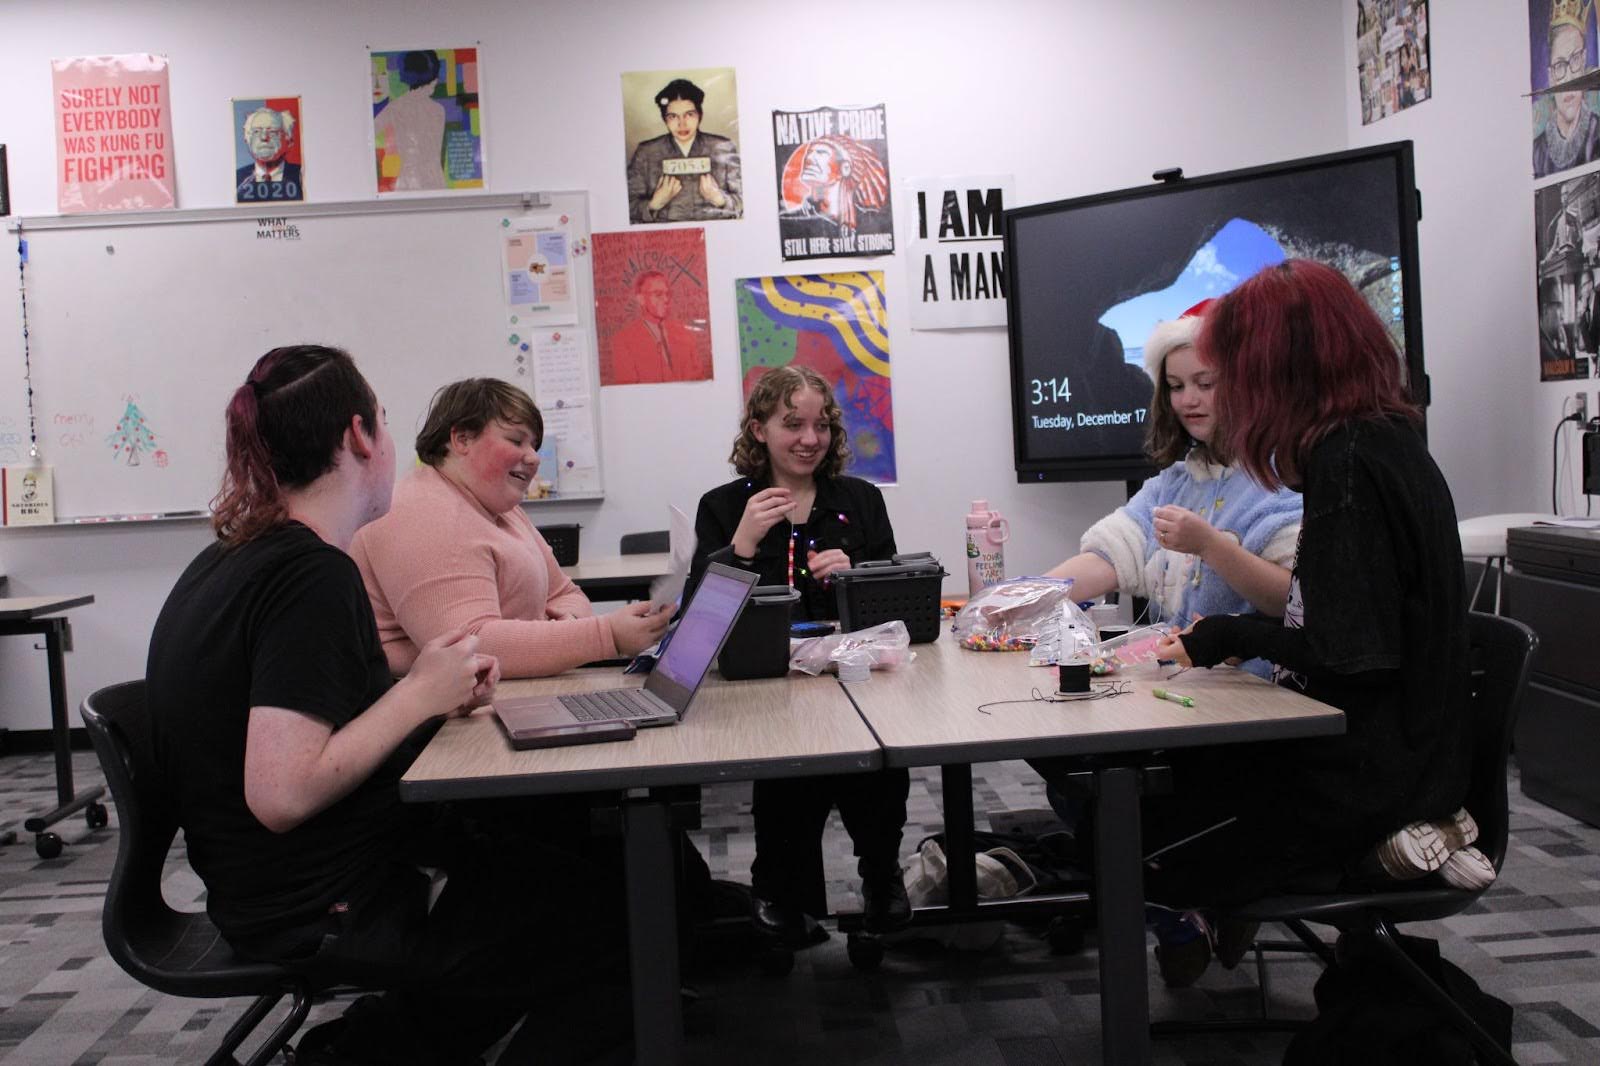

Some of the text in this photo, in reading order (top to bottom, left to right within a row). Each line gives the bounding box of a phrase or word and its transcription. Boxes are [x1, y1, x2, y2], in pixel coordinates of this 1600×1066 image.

[61, 85, 161, 109] SURELY NOT
[63, 109, 161, 133] EVERYBODY
[775, 109, 885, 145] NATIVE PRIDE
[64, 132, 164, 153] WAS KUNG FU
[64, 154, 165, 183] FIGHTING
[243, 182, 297, 199] 2020
[257, 217, 287, 226] WHAT
[917, 188, 1003, 239] I AM
[257, 230, 300, 239] MATTERS
[784, 238, 807, 256] STILL
[809, 237, 832, 255] HERE
[858, 233, 893, 251] STRONG
[923, 251, 1007, 302] A MAN
[1031, 377, 1072, 405] 3:14
[1032, 408, 1147, 431] Tuesday, December 17
